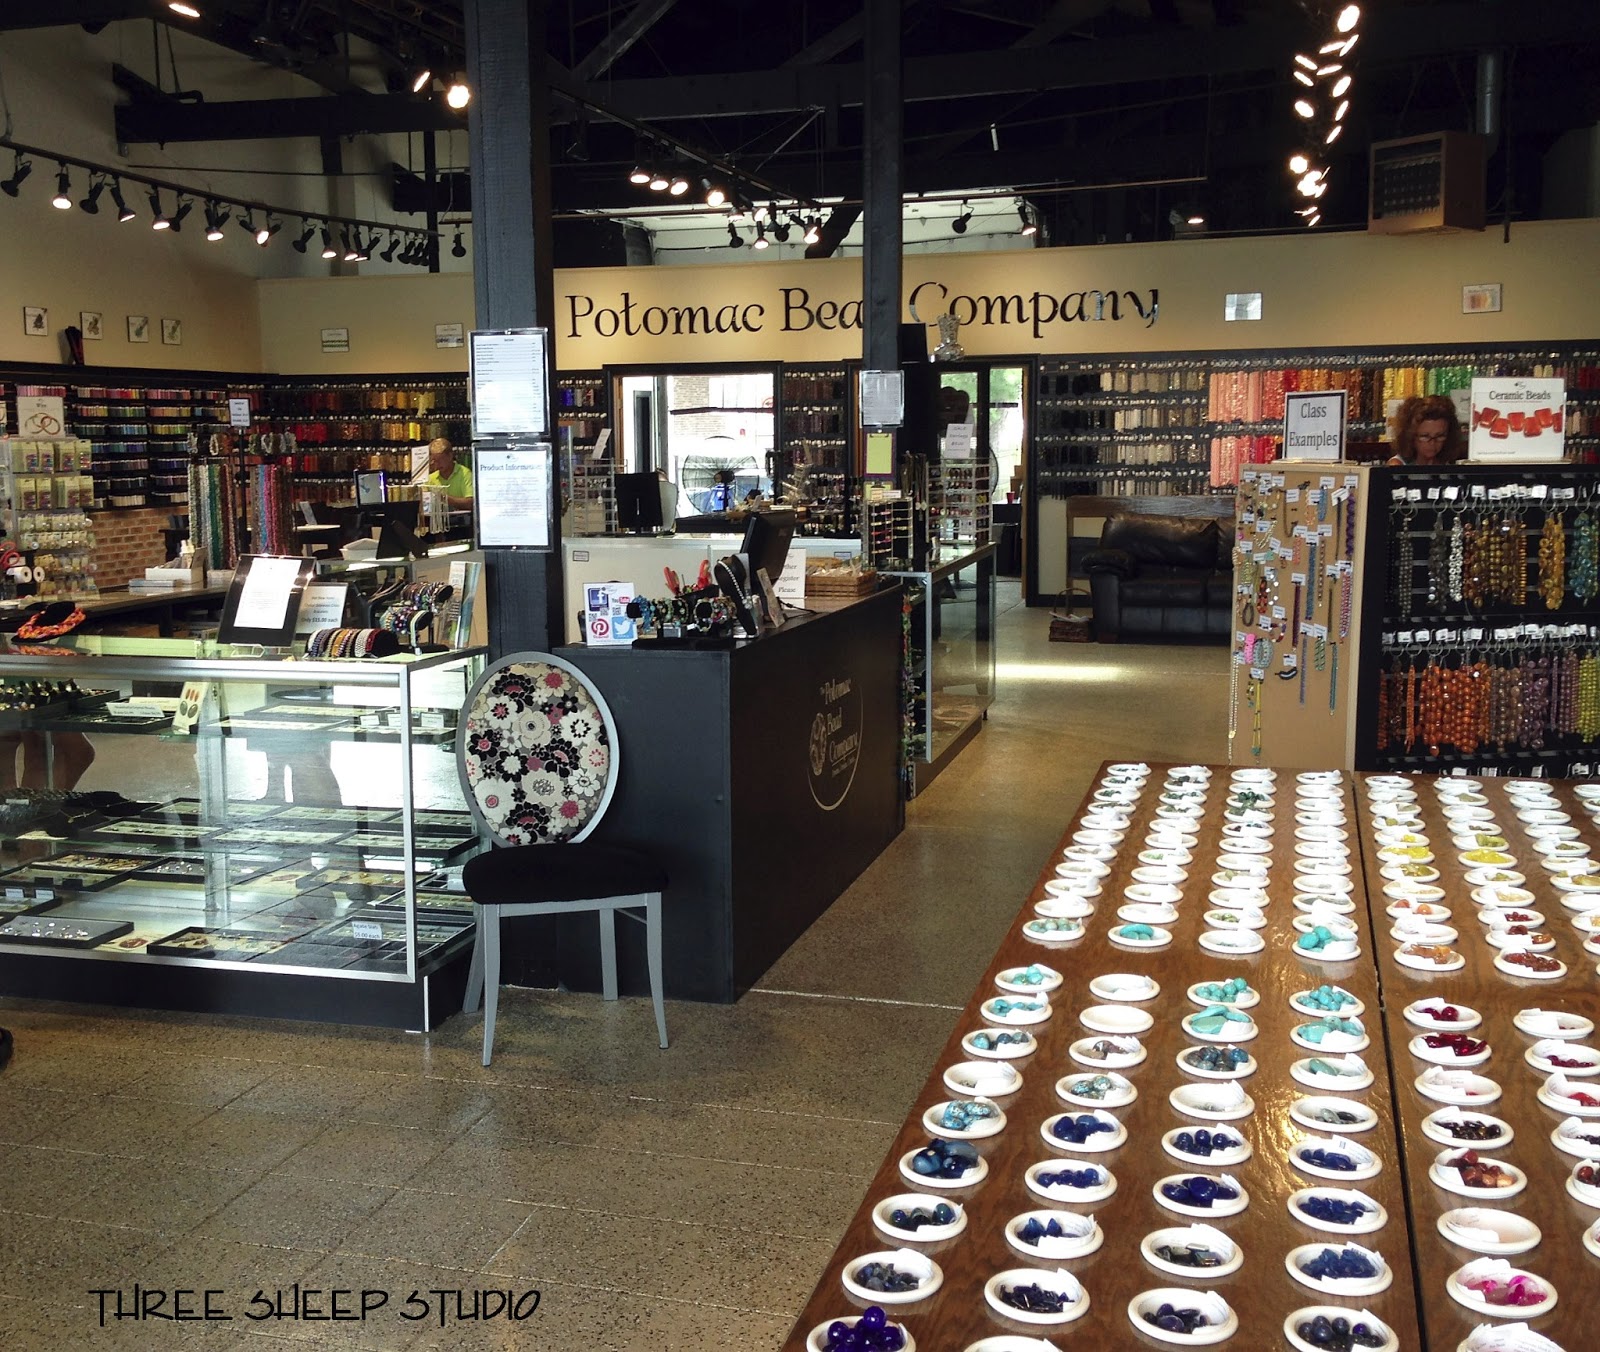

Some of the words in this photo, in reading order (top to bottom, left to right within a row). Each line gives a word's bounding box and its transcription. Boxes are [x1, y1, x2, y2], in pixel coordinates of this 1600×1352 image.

[565, 292, 765, 338] Potomac
[779, 287, 864, 332] Bea
[908, 281, 1160, 339] Company
[1489, 390, 1524, 400] Ceramic
[1525, 390, 1552, 400] Beads
[1300, 402, 1327, 418] Class
[1288, 430, 1338, 451] Examples
[480, 463, 504, 471] Product
